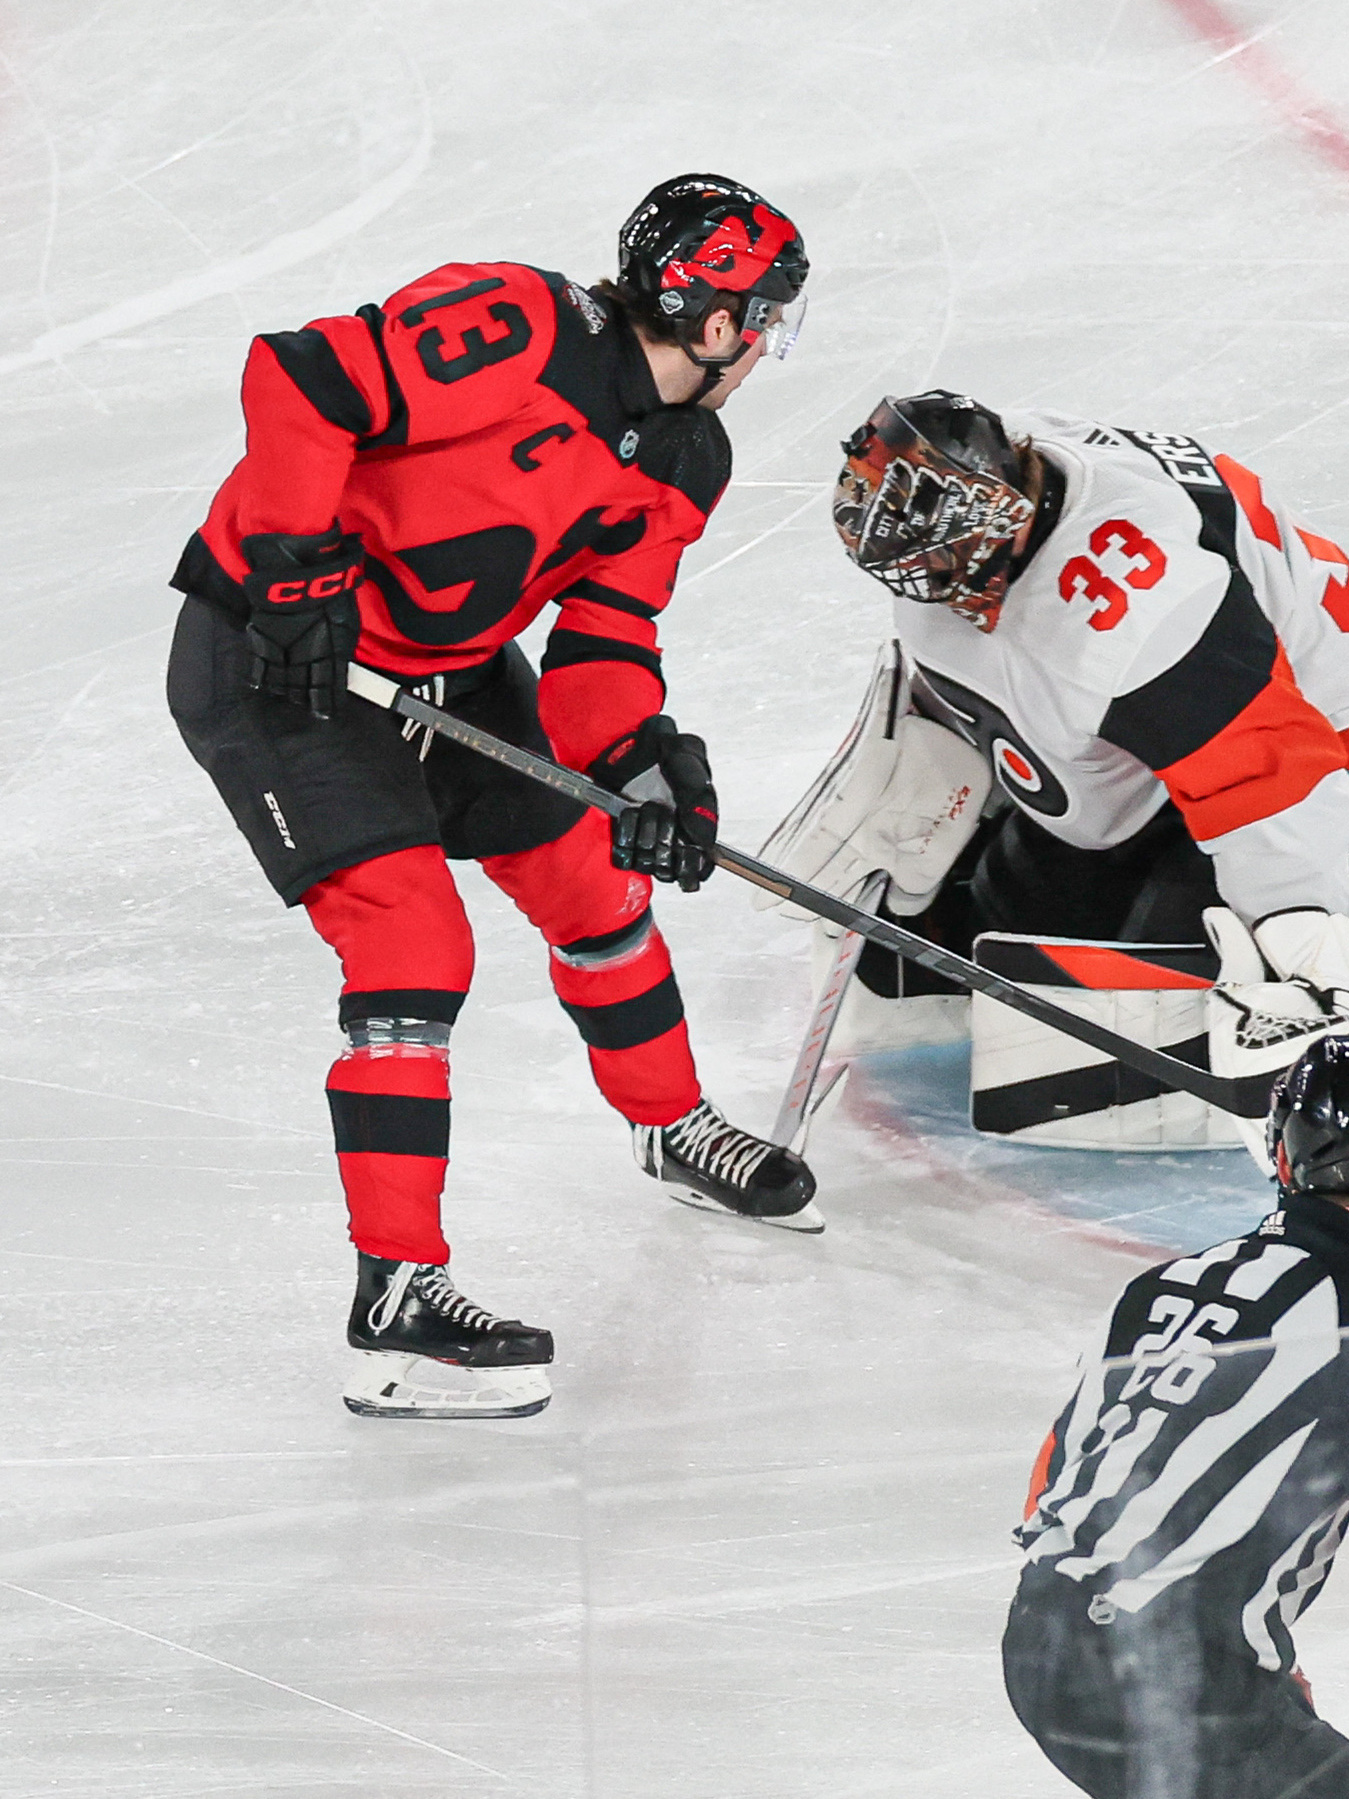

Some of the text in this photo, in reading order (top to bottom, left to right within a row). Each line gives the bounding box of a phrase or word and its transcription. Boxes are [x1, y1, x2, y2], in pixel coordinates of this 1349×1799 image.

[400, 277, 532, 385] 13
[511, 422, 577, 473] C
[1058, 519, 1167, 632] 33
[1118, 1294, 1240, 1406] 26
